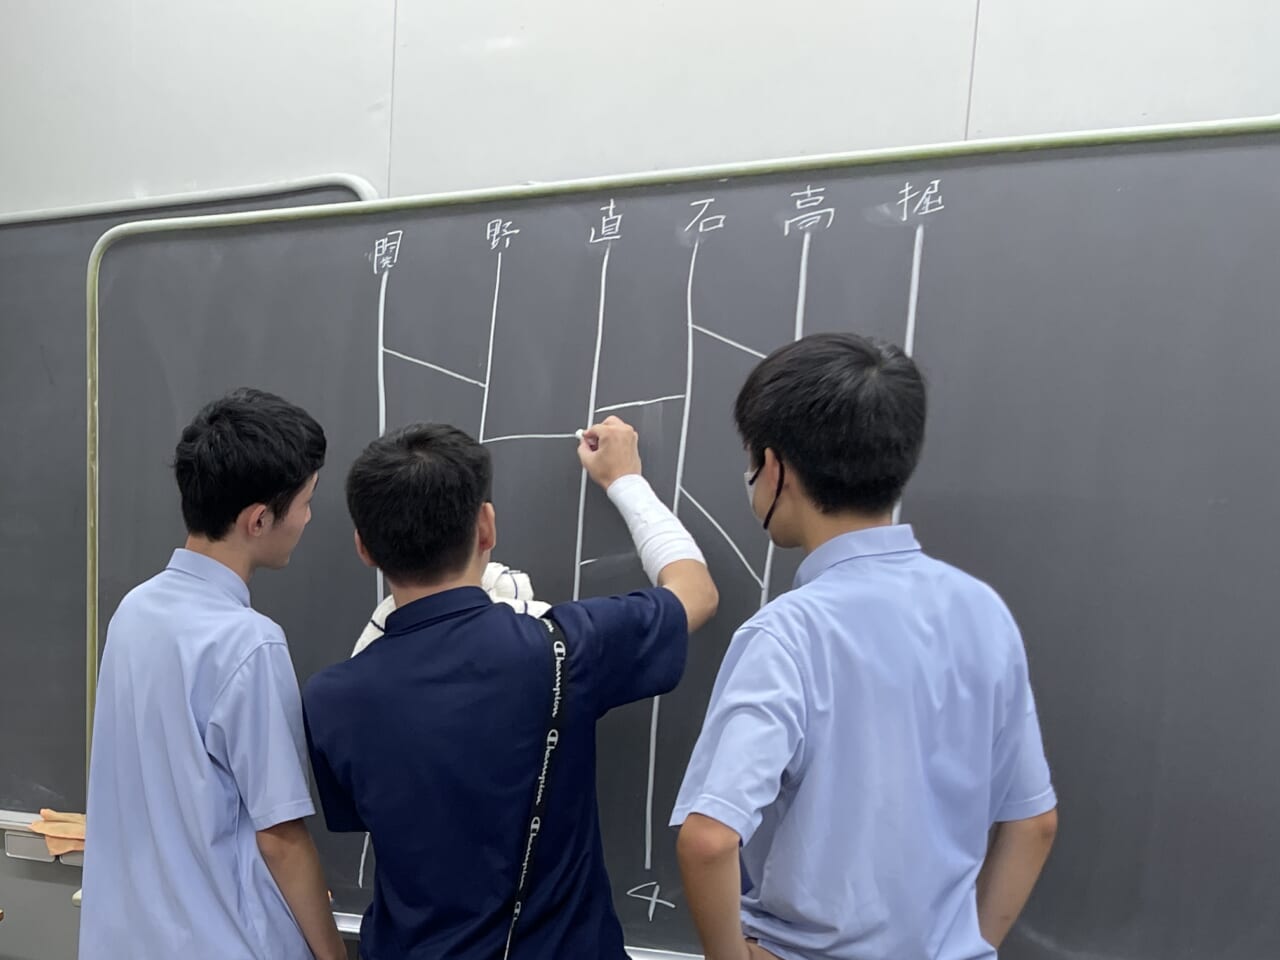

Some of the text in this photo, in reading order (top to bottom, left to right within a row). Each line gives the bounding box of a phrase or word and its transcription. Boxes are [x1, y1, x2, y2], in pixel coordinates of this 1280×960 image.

[486, 217, 520, 250] 野
[589, 197, 624, 244] 直
[683, 197, 726, 233] 石
[783, 184, 835, 237] 高
[551, 640, 567, 719] Champion
[535, 728, 559, 806] Champion
[626, 881, 676, 922] 4
